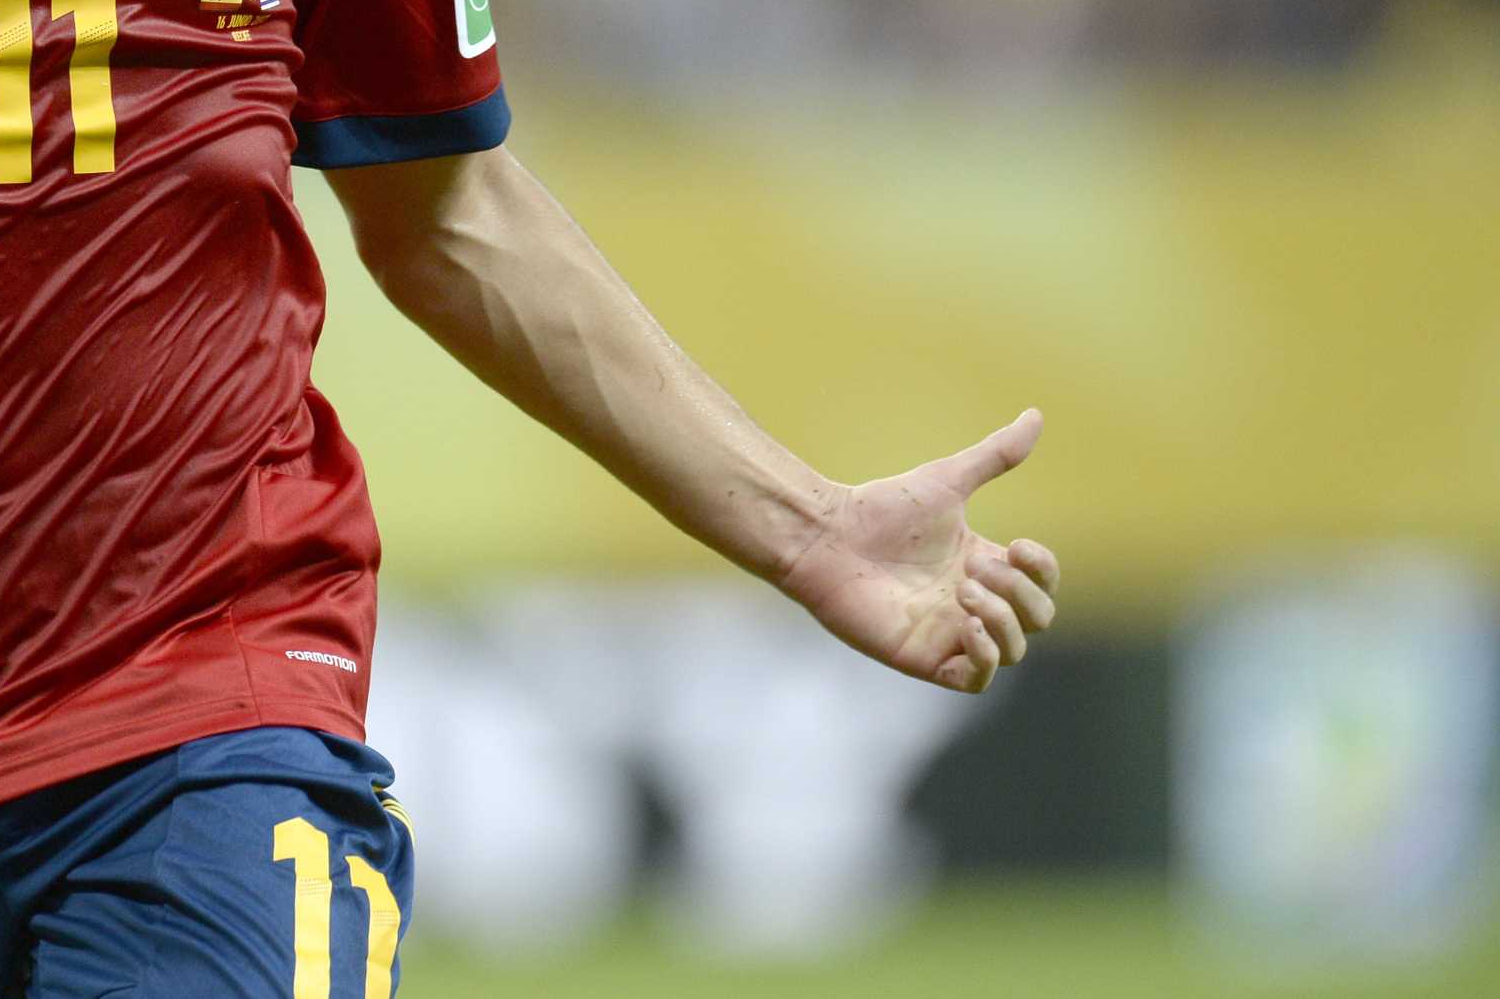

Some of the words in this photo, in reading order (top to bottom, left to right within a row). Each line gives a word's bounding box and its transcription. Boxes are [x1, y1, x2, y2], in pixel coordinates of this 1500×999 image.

[216, 15, 226, 29] 16
[285, 650, 357, 673] FORMOTION
[273, 817, 400, 999] 11
